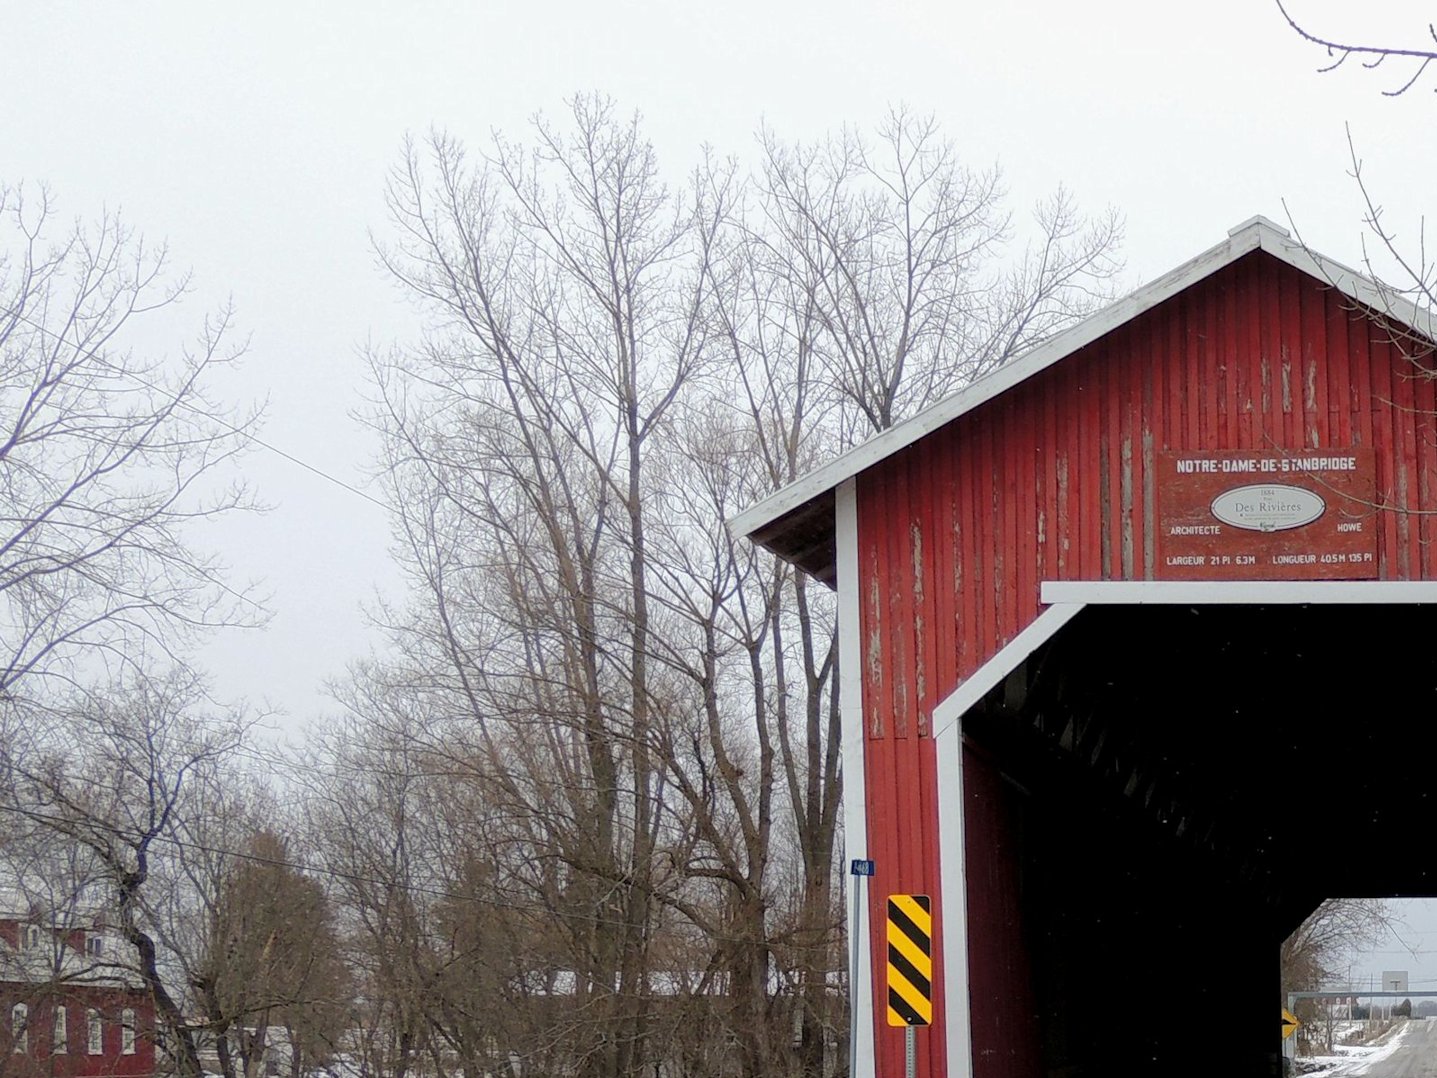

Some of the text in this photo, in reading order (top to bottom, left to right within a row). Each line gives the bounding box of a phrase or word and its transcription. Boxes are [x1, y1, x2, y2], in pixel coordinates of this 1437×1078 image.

[1235, 501, 1302, 513] Des Rivières
[1170, 525, 1221, 535] ARCHITECTE
[1337, 522, 1362, 532] HOWE
[1166, 556, 1205, 566] LARGEUR
[1210, 556, 1220, 565] 21
[1222, 556, 1231, 565] PI
[1272, 554, 1317, 565] LONGUEUR
[1363, 552, 1373, 562] PI
